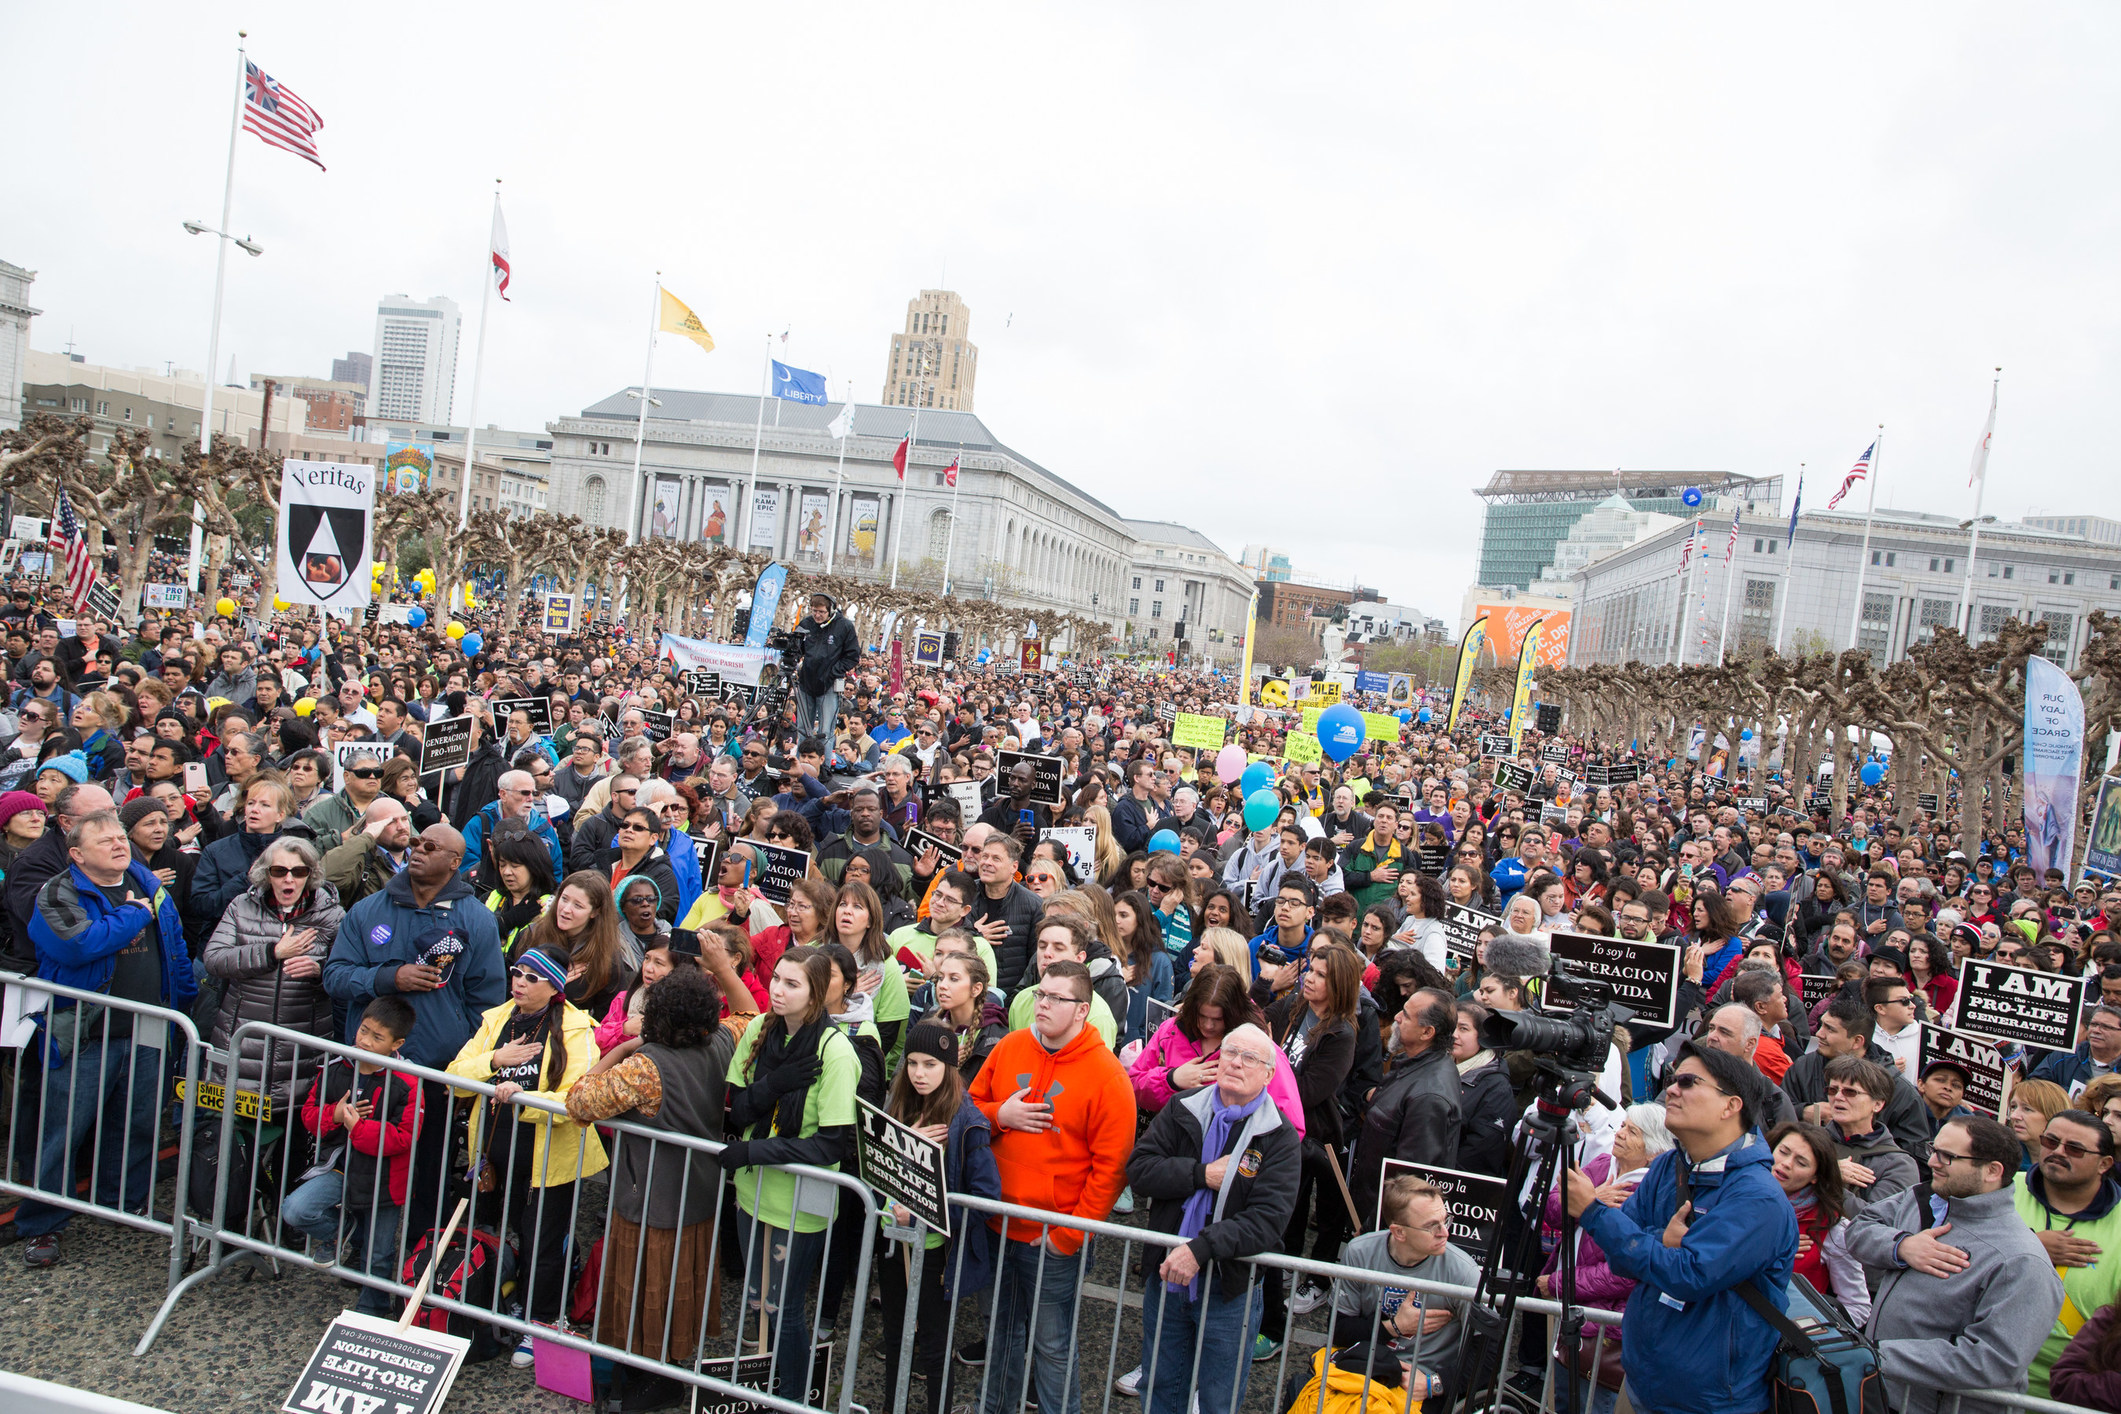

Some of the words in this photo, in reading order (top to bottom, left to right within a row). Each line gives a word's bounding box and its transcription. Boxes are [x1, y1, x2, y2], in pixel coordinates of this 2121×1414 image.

[784, 388, 823, 402] LIBERTY
[292, 466, 366, 495] Veritas
[755, 498, 777, 506] RAMA
[164, 594, 183, 602] LIFE
[548, 607, 569, 617] Choose
[552, 616, 563, 626] Life
[1514, 609, 1542, 629] DAZZLES
[1350, 618, 1418, 640] TRUTH
[1546, 641, 1566, 661] JOY
[689, 653, 719, 665] CATHOLIC
[719, 658, 744, 669] PARISH
[1310, 684, 1340, 696] MILE!
[425, 731, 470, 748] GENERACION
[430, 744, 463, 758] PRO-VIDA
[1743, 799, 1765, 807] AM
[1812, 798, 1830, 806] AM
[768, 852, 779, 862] soy
[779, 851, 788, 861] la
[1591, 942, 1605, 955] Yo
[1606, 948, 1624, 961] soy
[1625, 946, 1637, 960] la
[1972, 966, 1992, 989] I
[1998, 971, 2073, 1004] AM
[2014, 996, 2026, 1004] the
[1968, 995, 2069, 1025] PRO-LIFE
[1966, 1011, 2067, 1037] GENERATION
[1926, 1028, 1941, 1050] I
[1946, 1037, 2003, 1072] AM
[200, 1094, 243, 1114] CHOE
[861, 1106, 877, 1138] I
[881, 1121, 936, 1174] AM
[865, 1141, 938, 1200] PRO-LIFE
[866, 1161, 939, 1213] GENERATION
[1438, 1180, 1455, 1195] soy
[1456, 1179, 1468, 1194] la
[331, 1339, 436, 1376] GENERATION
[320, 1353, 429, 1395] PRO-LIFE
[360, 1381, 374, 1392] the
[299, 1379, 387, 1414] AM
